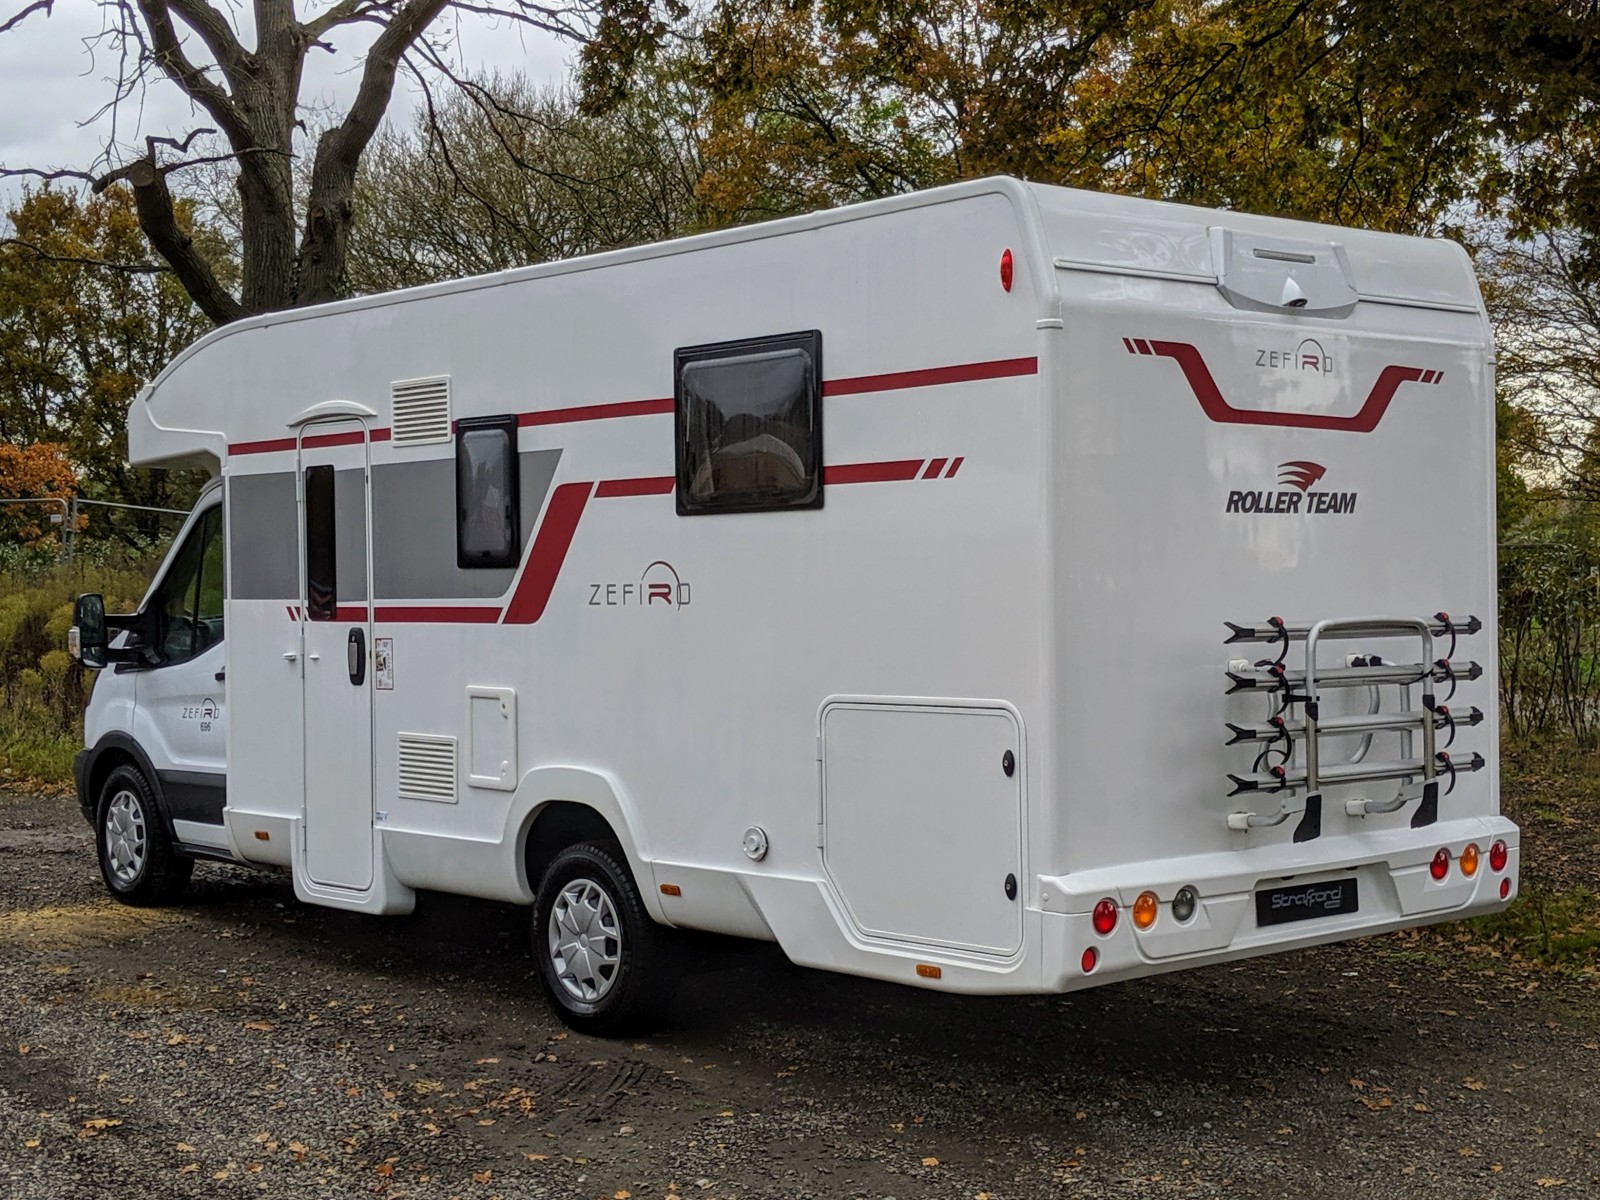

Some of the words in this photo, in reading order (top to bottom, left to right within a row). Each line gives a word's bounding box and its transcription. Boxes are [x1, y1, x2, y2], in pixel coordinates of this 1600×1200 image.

[1255, 346, 1333, 376] ZEFIRO
[1225, 490, 1303, 514] ROLLER
[1306, 492, 1358, 514] TEAM
[588, 580, 691, 611] ZEFIRO
